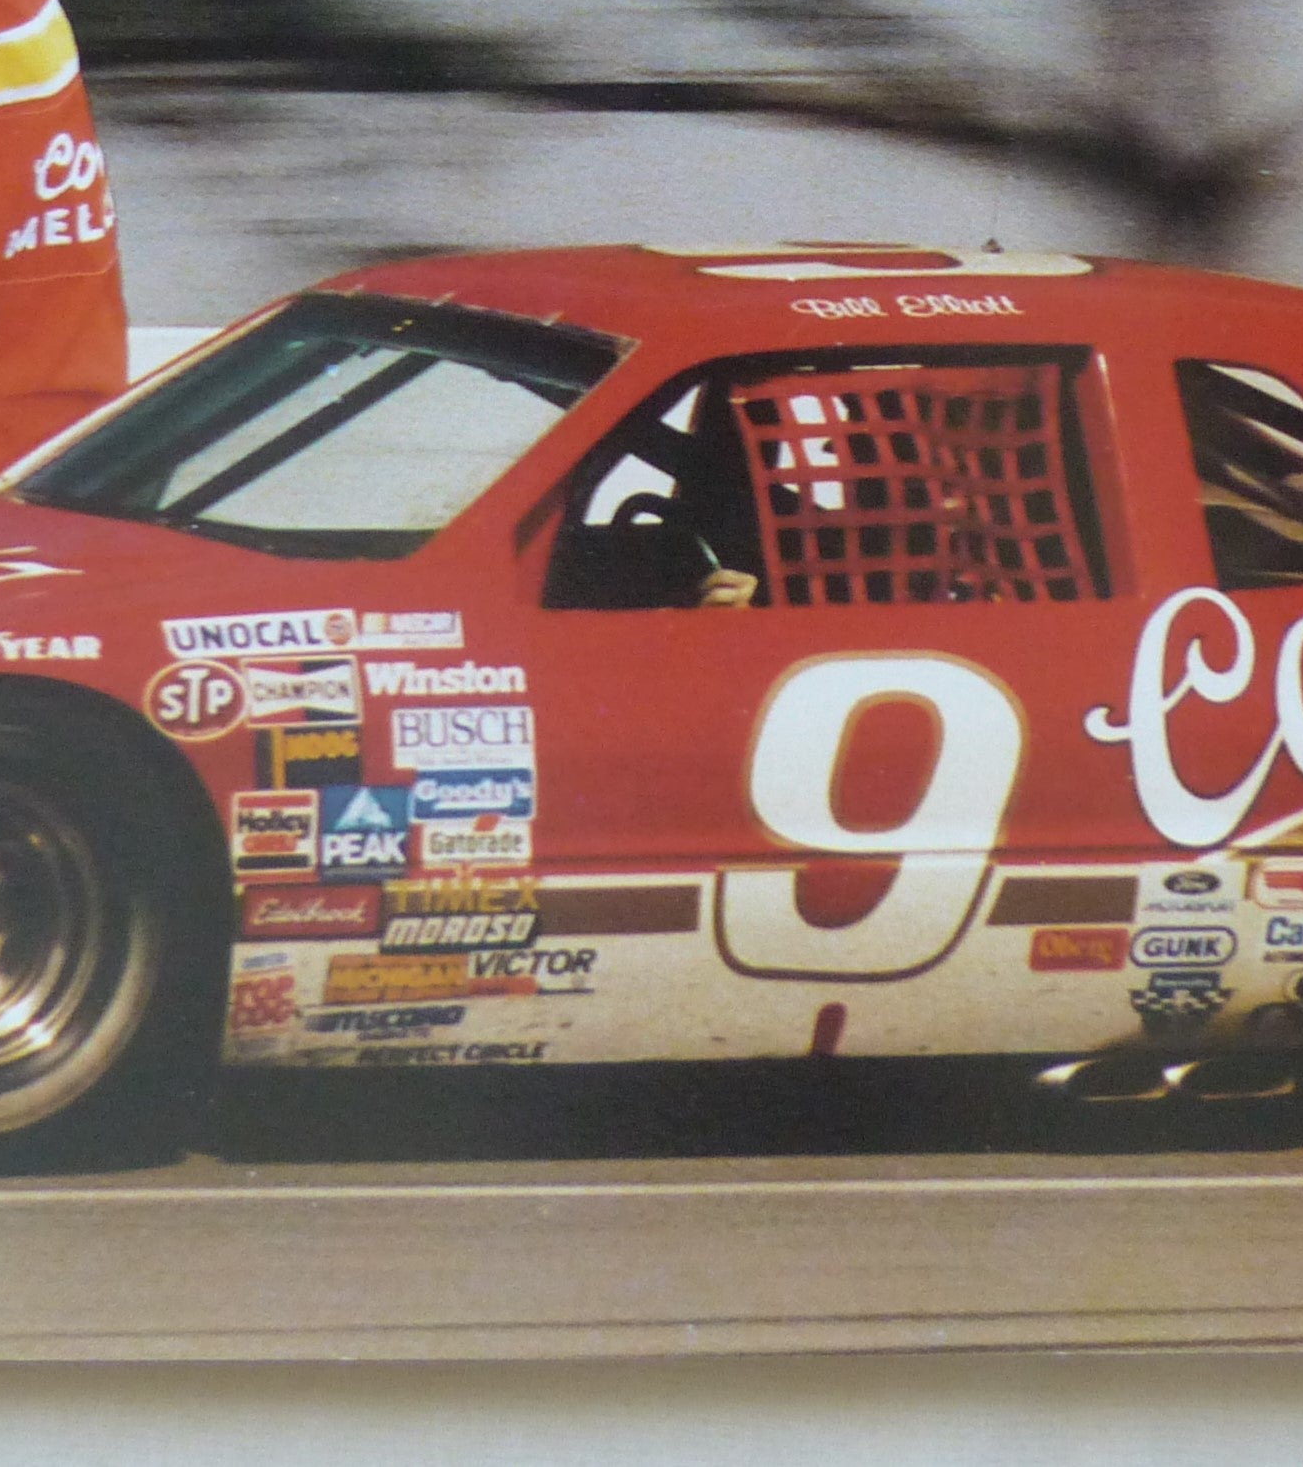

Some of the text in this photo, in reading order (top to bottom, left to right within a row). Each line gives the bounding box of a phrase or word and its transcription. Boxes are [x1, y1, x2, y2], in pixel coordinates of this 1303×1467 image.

[791, 292, 1026, 320] Bill Elliott
[169, 619, 322, 652] UNOCAL
[252, 679, 353, 703] CHAMPION
[364, 659, 528, 696] Winston
[157, 666, 235, 724] STP
[397, 709, 531, 747] BUSCH
[237, 809, 311, 839] Holley
[713, 650, 1031, 984] 9
[321, 832, 407, 866] PEAK
[429, 832, 523, 855] Gatorade
[384, 878, 540, 913] TIMEX
[383, 912, 536, 947] MOROSO
[471, 947, 597, 977] VICTOR
[1143, 936, 1221, 958] GUNK
